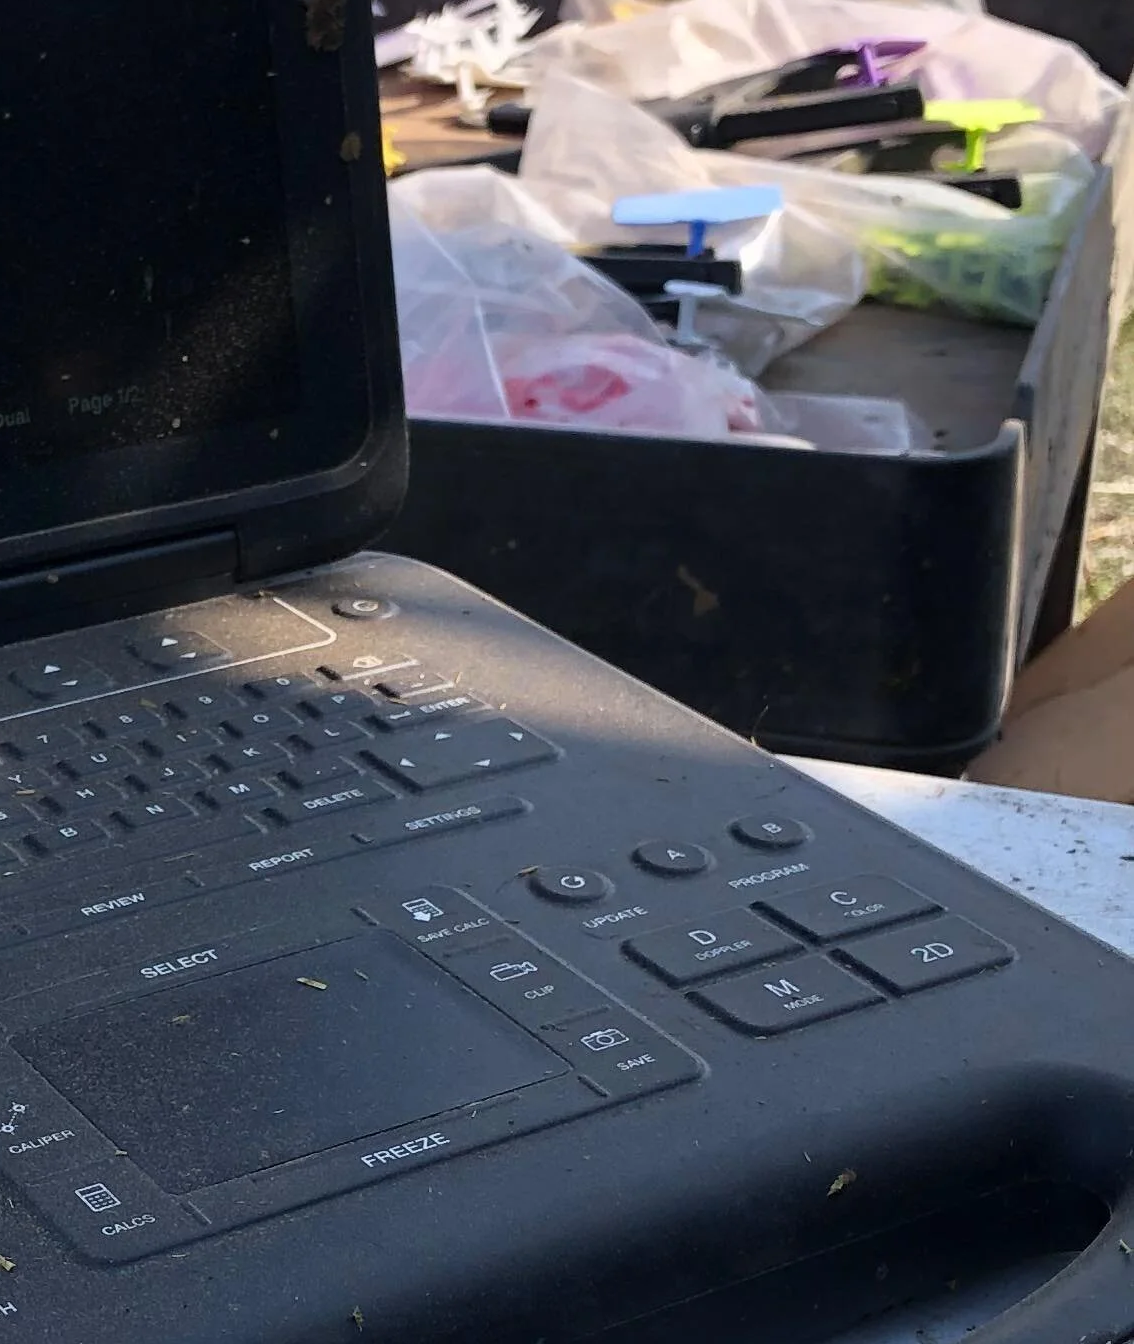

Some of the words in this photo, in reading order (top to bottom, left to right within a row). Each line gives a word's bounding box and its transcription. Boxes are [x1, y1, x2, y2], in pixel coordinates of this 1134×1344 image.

[67, 393, 113, 415] Page
[36, 734, 48, 744] 7
[118, 715, 134, 724] 8
[198, 696, 213, 705] 9
[275, 677, 290, 686] 0
[7, 774, 22, 784] Y
[90, 753, 108, 763] U
[176, 734, 187, 742] I
[252, 714, 270, 723] O
[331, 695, 345, 704] P
[75, 788, 95, 799] H
[163, 767, 175, 777] J
[242, 747, 261, 757] K
[323, 728, 340, 737] L
[419, 695, 470, 714] ENTER
[59, 827, 78, 838] B
[145, 804, 164, 815] N
[228, 783, 251, 794] M
[302, 788, 364, 809] DELETE
[80, 892, 145, 916] REVIEW
[248, 848, 314, 871] REPORT
[404, 806, 482, 830] SETTINGS
[666, 849, 686, 861] A
[728, 862, 809, 889] PROGRAM
[830, 891, 857, 905] C
[582, 906, 648, 928] UPDATE
[416, 927, 453, 944] SAVE
[453, 917, 490, 933] CALC
[688, 929, 717, 946] D
[694, 939, 753, 961] DOPPLER
[910, 942, 954, 963] 2D
[140, 948, 218, 979] SELECT
[524, 985, 555, 1000] CLIP
[763, 979, 800, 998] M
[783, 994, 824, 1011] MODE
[616, 1053, 656, 1071] SAVE
[8, 1128, 75, 1155] CALIPER
[360, 1132, 451, 1168] FREEZE
[101, 1214, 156, 1236] CALCS
